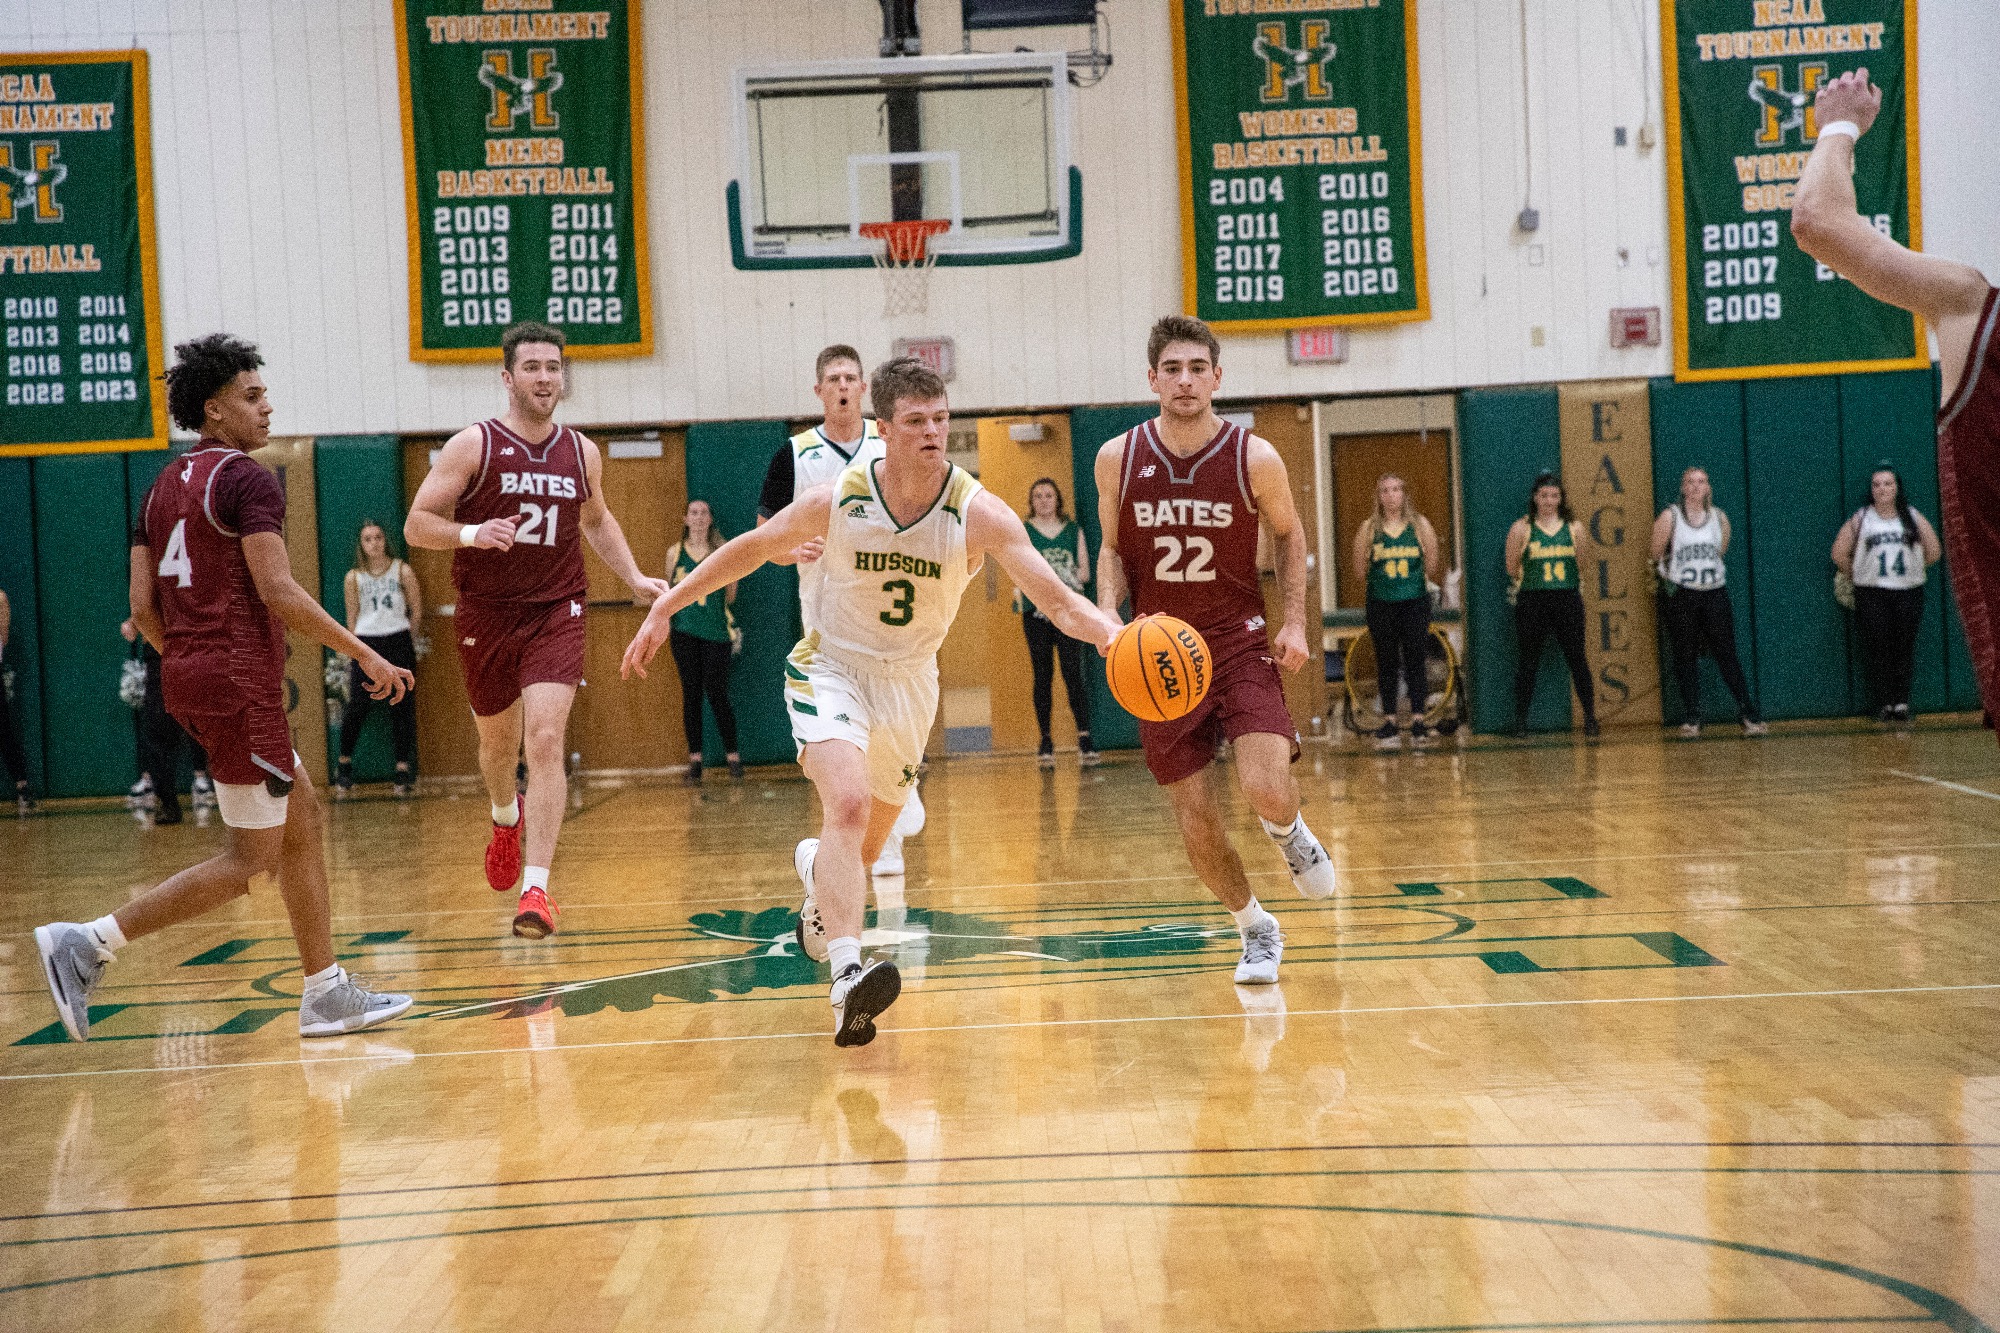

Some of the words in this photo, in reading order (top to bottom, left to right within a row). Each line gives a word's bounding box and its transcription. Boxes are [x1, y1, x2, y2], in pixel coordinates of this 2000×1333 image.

[426, 12, 610, 43] TOURNAMENT
[1754, 0, 1825, 27] NCAA
[1697, 22, 1884, 61] TOURNAMENT
[0, 73, 56, 102] CAA
[1238, 108, 1358, 138] WOMENS
[485, 138, 564, 166] MENS
[1213, 135, 1388, 170] BASKETBALL
[1735, 152, 1812, 183] WOM
[437, 167, 614, 197] BASKETBALL
[1209, 176, 1284, 205] 2004
[1319, 171, 1389, 200] 2010
[1743, 183, 1799, 212] SOC
[434, 205, 509, 234] 2009
[552, 203, 613, 231] 2011
[1217, 212, 1280, 241] 2011
[1322, 206, 1390, 236] 2016
[439, 236, 509, 265] 2013
[549, 234, 618, 261] 2014
[1703, 220, 1778, 251] 2003
[1215, 244, 1281, 272] 2017
[1324, 237, 1393, 266] 2018
[441, 267, 509, 295] 2016
[551, 265, 618, 293] 2017
[1216, 275, 1284, 303] 2019
[1324, 267, 1398, 297] 2020
[1704, 256, 1778, 288] 2007
[5, 296, 59, 319] 2010
[79, 295, 126, 317] 2011
[443, 298, 512, 326] 2019
[547, 297, 622, 324] 2022
[1706, 292, 1781, 324] 2009
[7, 325, 59, 348] 2013
[79, 323, 130, 345] 2014
[81, 352, 132, 374] 2019
[7, 382, 65, 405] 2022
[81, 380, 137, 402] 2023
[500, 472, 577, 499] BATES
[514, 502, 559, 547] 21
[1133, 499, 1233, 528] BATES
[158, 518, 193, 588] 4
[855, 551, 942, 580] HUSSON
[1154, 535, 1217, 583] 22
[1589, 400, 1630, 702] EAGLES
[1878, 549, 1907, 577] 14
[879, 579, 915, 627] 3
[1153, 650, 1181, 699] NCAA
[1177, 629, 1205, 697] Wilson
